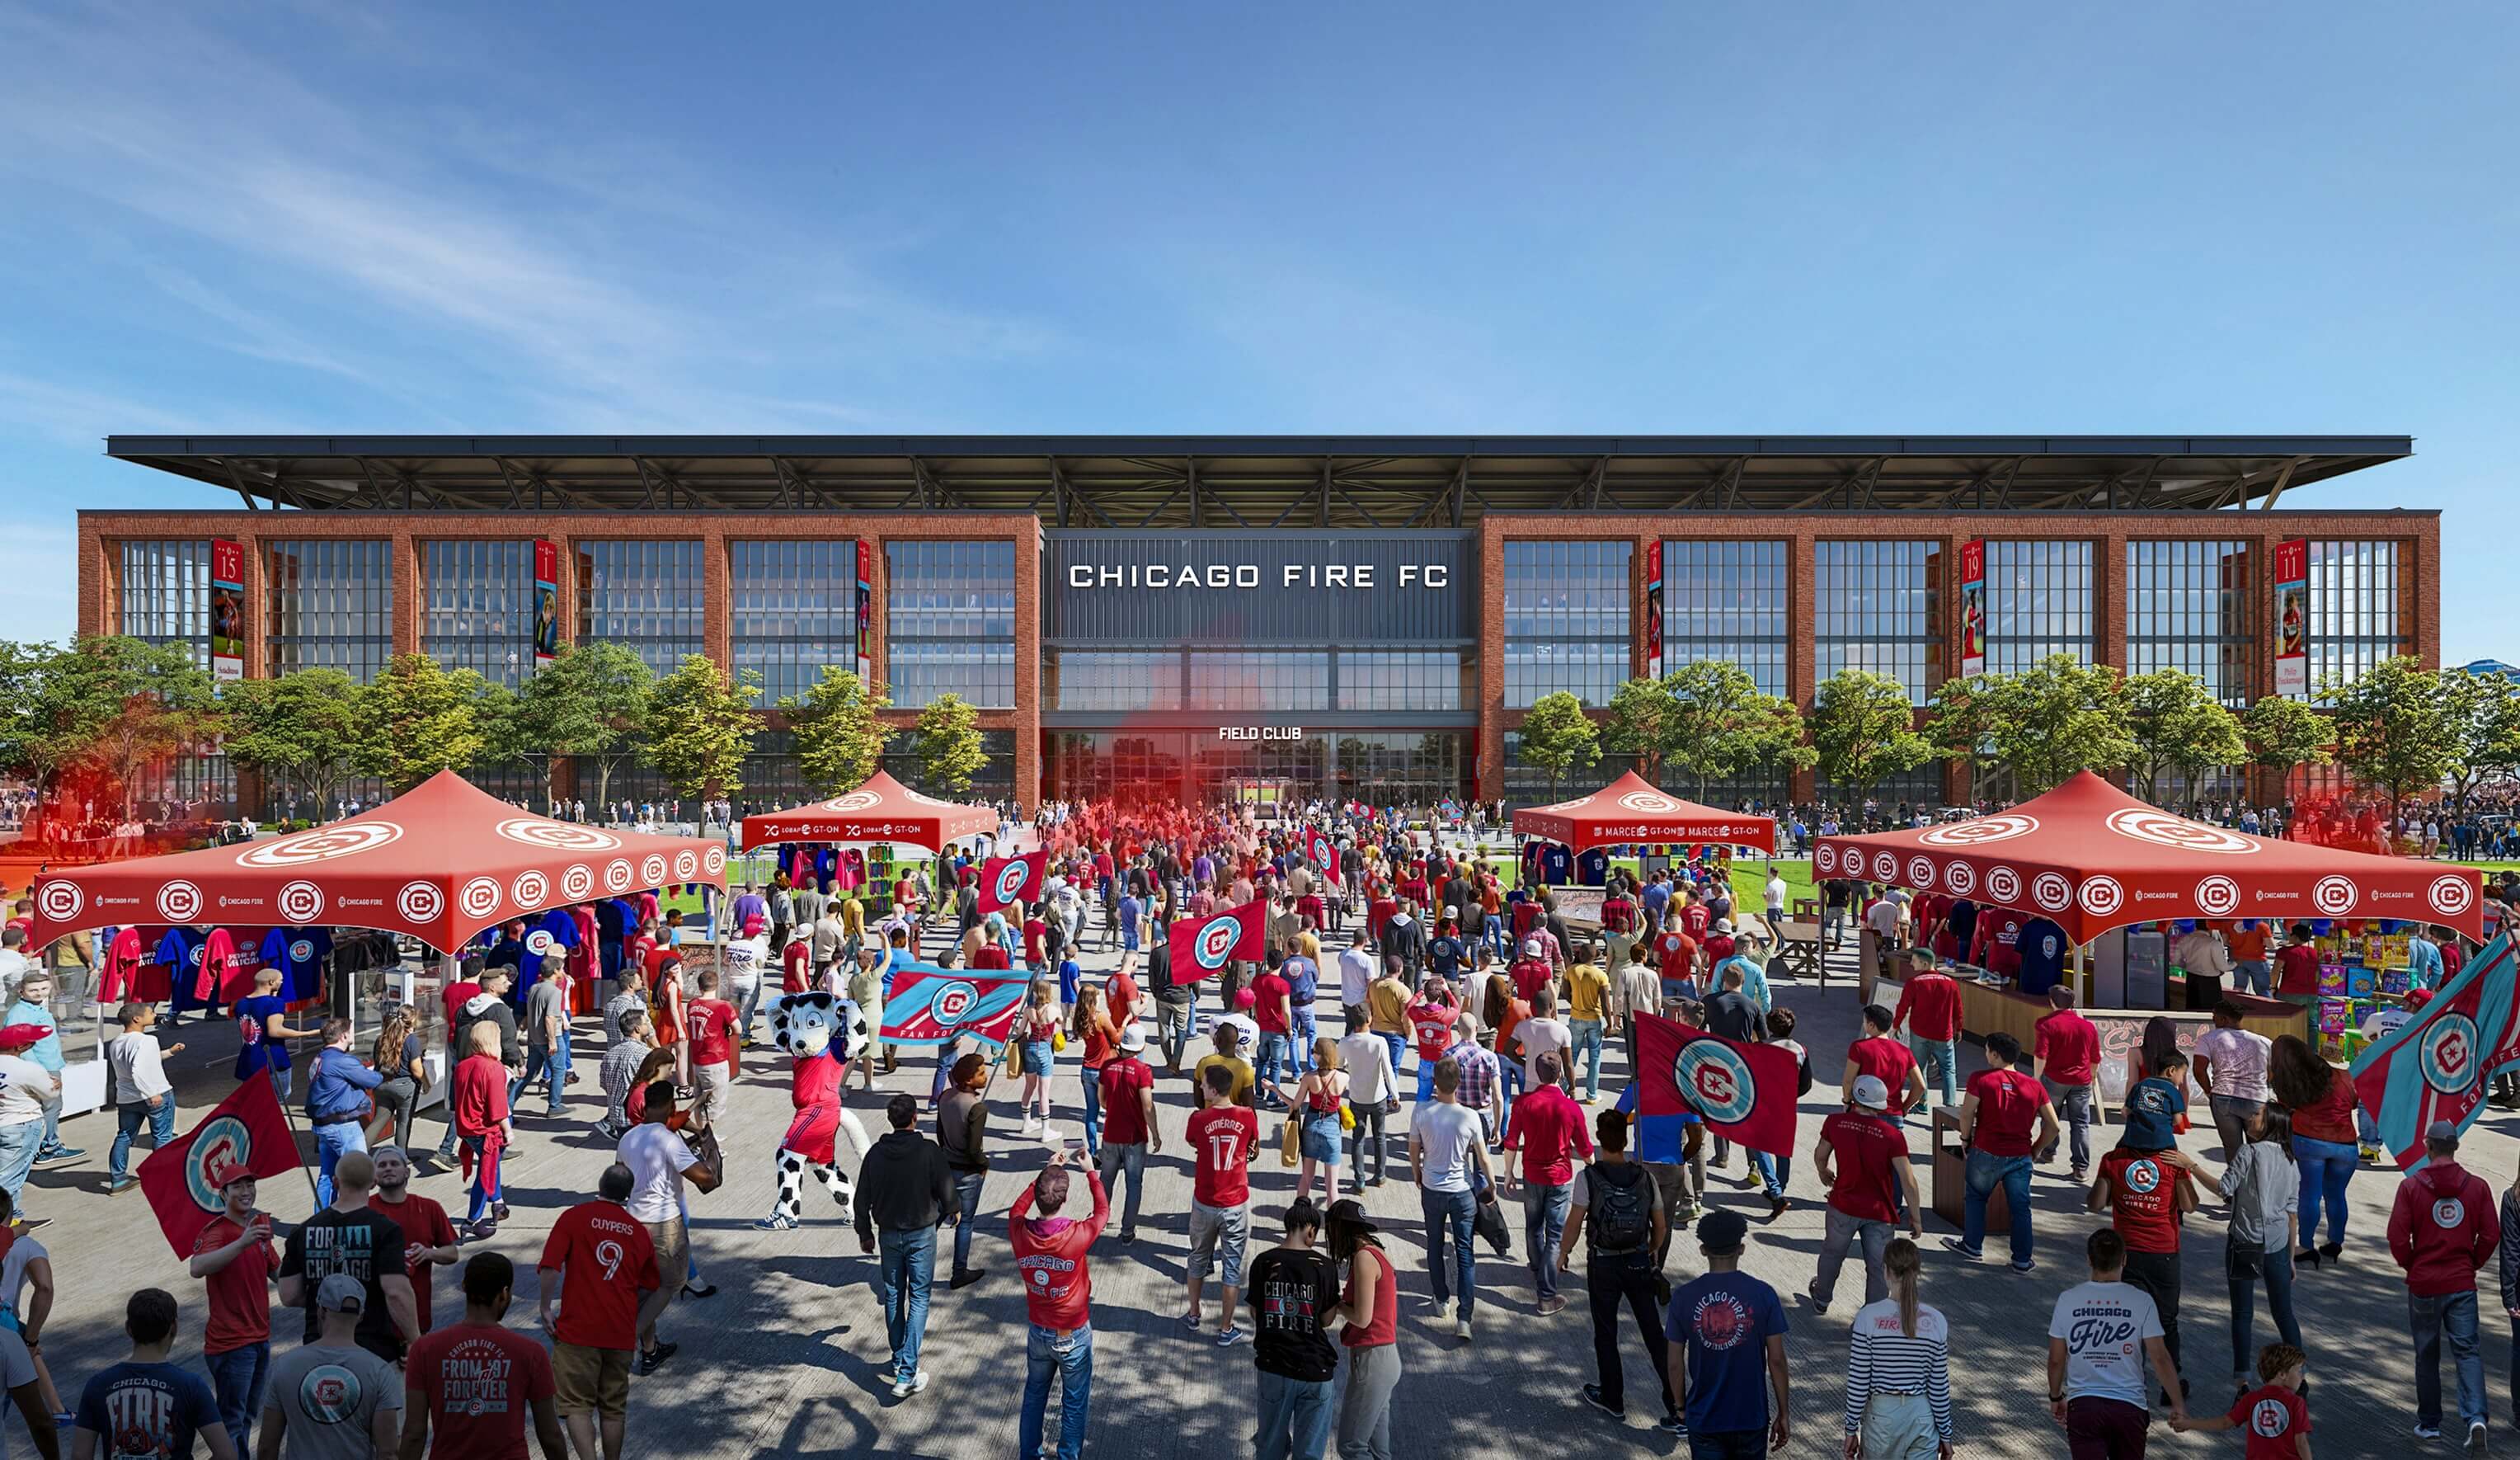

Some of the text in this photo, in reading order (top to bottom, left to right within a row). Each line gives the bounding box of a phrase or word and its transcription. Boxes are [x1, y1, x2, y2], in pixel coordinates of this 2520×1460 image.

[223, 555, 237, 579] 15
[1070, 564, 1449, 588] CHICAGO FIRE FC
[1967, 555, 1979, 579] 19
[2284, 556, 2297, 579] 11
[1219, 727, 1302, 740] FIELD CLUB
[689, 1015, 708, 1041] 17
[899, 1029, 925, 1038] FAN
[959, 1022, 989, 1036] LIFE
[2104, 1023, 2211, 1061] Spal
[2460, 1047, 2520, 1114] FOR LIFE
[1204, 1116, 1245, 1134] GUTIÉRREZ
[1209, 1134, 1239, 1171] 17
[2123, 1194, 2161, 1203] CHICAGO
[306, 1226, 335, 1249] FOR
[590, 1217, 634, 1236] CUYPERS
[596, 1239, 624, 1281] 9
[1264, 1281, 1314, 1302] CHICAGO
[1694, 1291, 1746, 1321] CHICAGO FIRE
[2072, 1307, 2132, 1318] CHICAGO
[1266, 1314, 1314, 1335] FIRE
[2070, 1318, 2136, 1354] Fire
[449, 1339, 477, 1358] CHICAGO
[479, 1339, 497, 1354] FIRE
[442, 1359, 482, 1378] FROM
[111, 1378, 167, 1389] CHICAGO
[444, 1380, 508, 1399] FOREVER
[106, 1387, 174, 1447] FIRE
